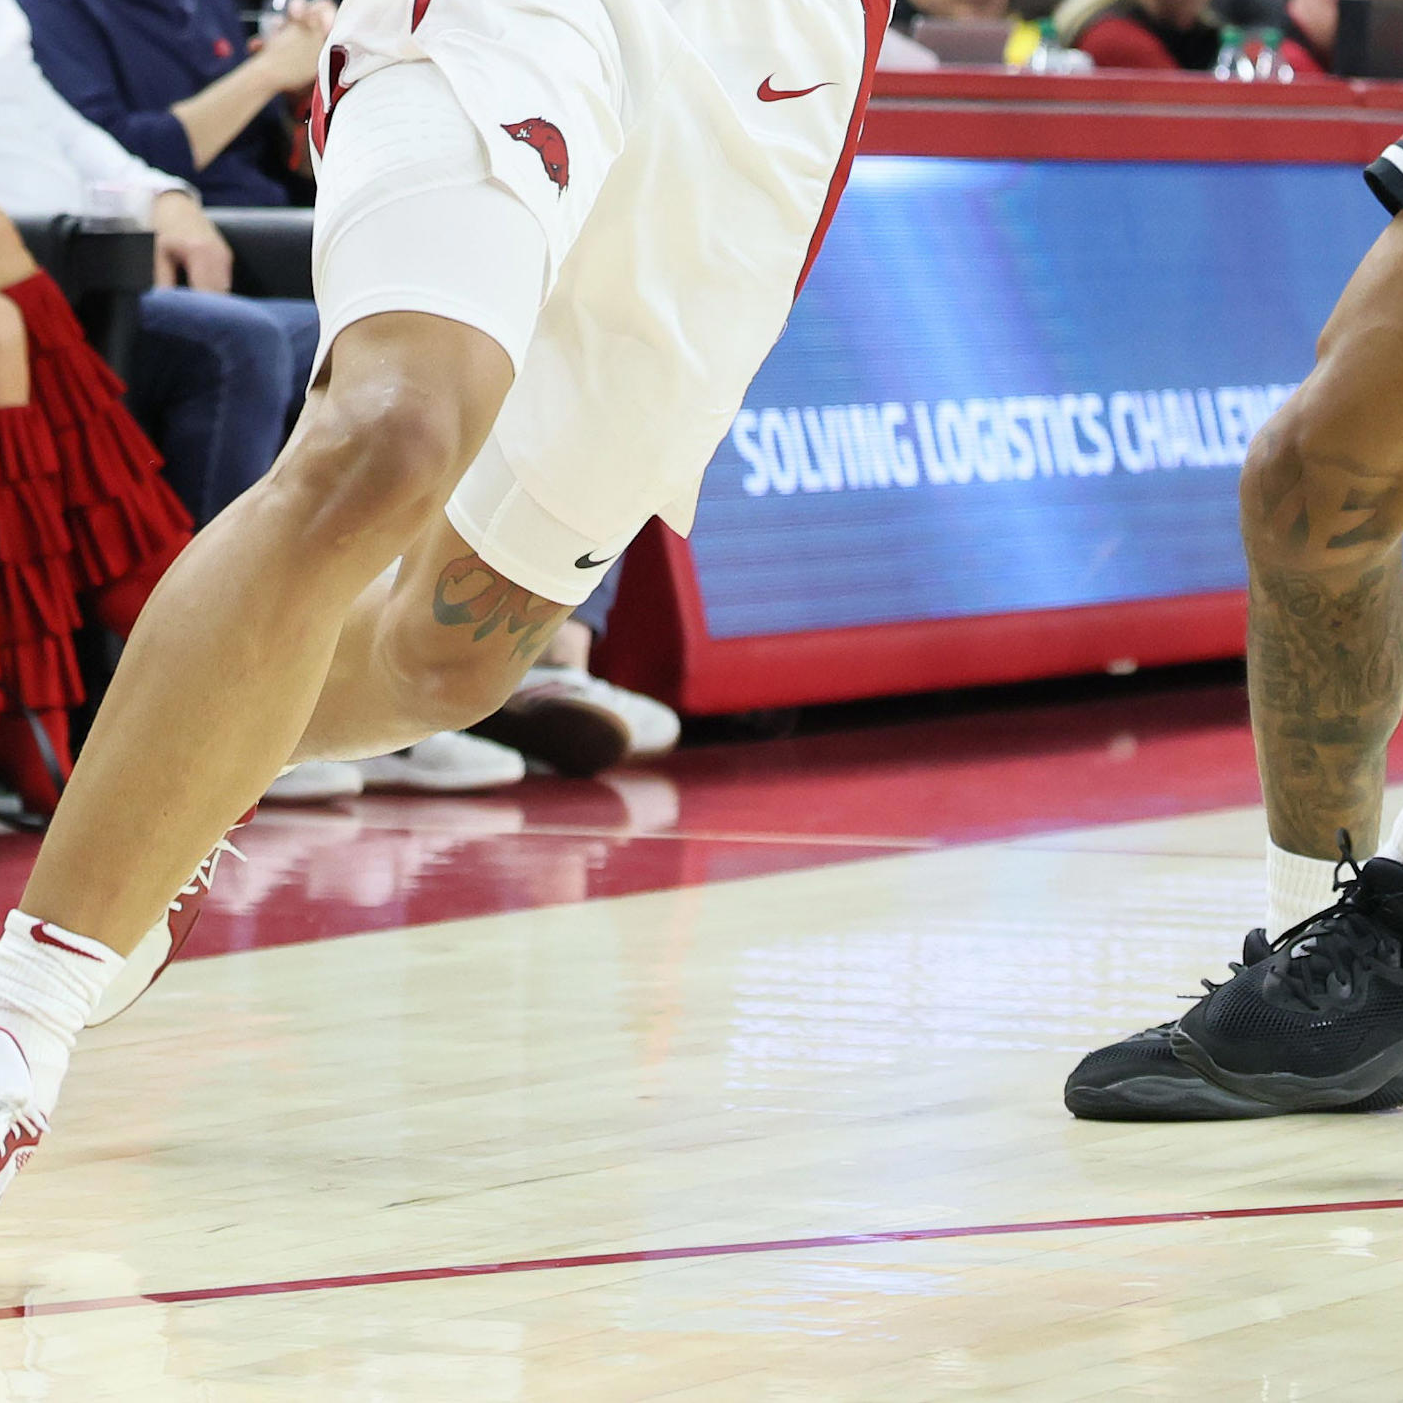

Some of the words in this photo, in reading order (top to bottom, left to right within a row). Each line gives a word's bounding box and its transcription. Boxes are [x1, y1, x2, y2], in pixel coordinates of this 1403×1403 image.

[732, 401, 920, 497] SOLVING
[913, 392, 1116, 487] LOGISTICS
[1108, 383, 1303, 474] CHALLEN
